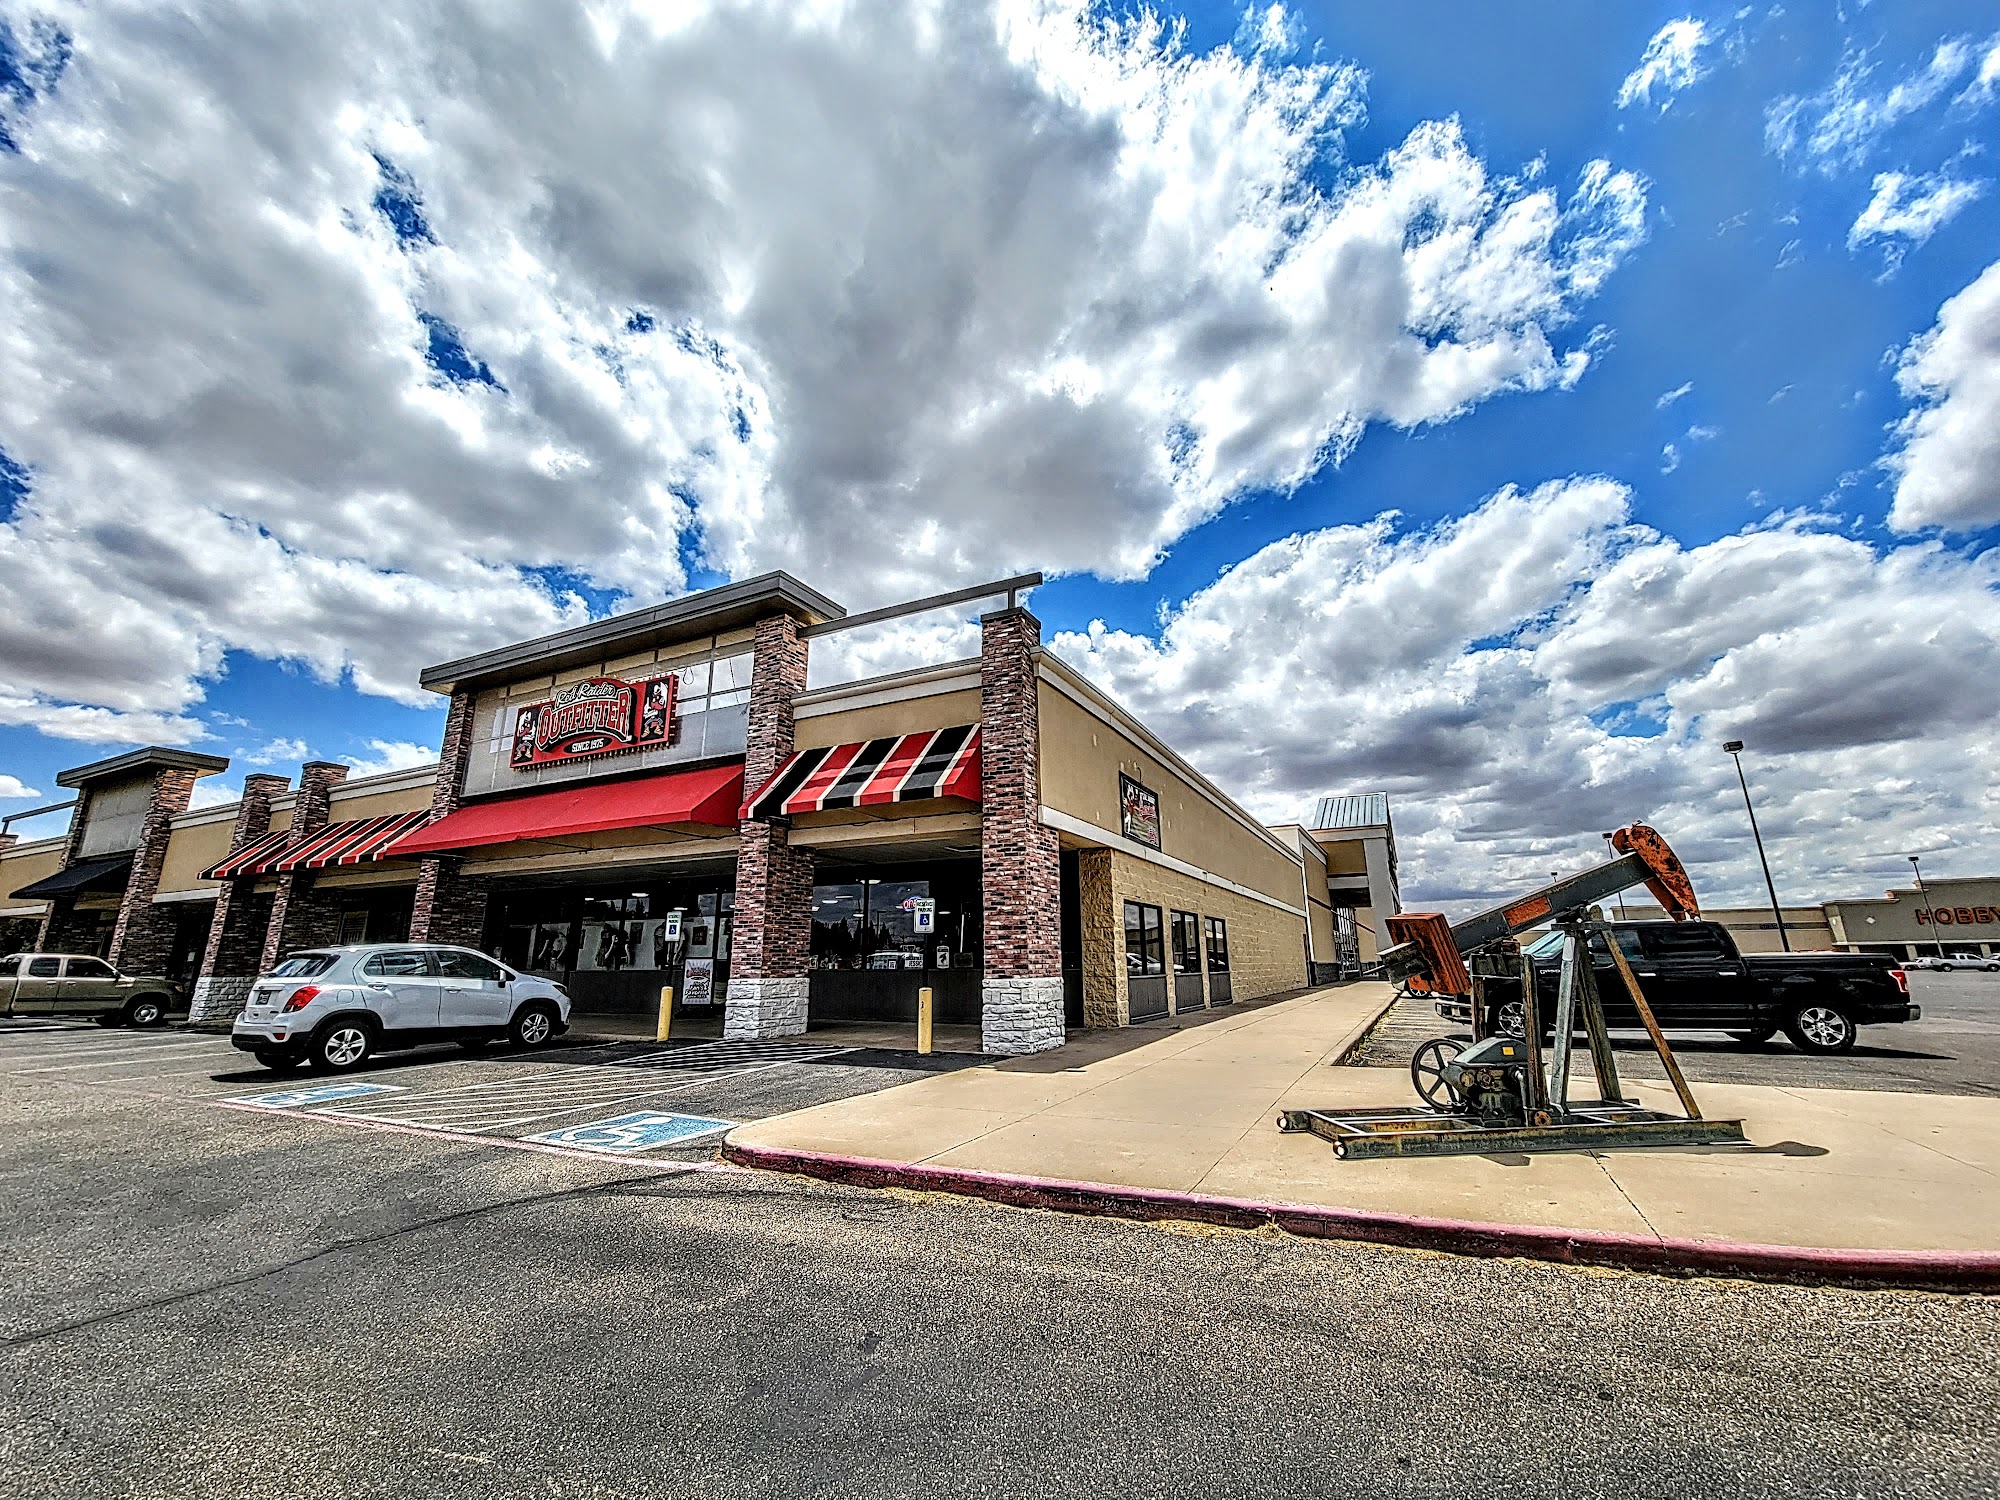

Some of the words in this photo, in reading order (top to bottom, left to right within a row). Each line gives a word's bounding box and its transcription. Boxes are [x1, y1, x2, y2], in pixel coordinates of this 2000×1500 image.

[556, 685, 578, 707] Red
[578, 682, 616, 698] Raider
[536, 688, 631, 750] OUTFITTER
[571, 742, 590, 752] SINCE
[590, 738, 604, 749] 1975
[1915, 906, 2000, 925] HOBBY
